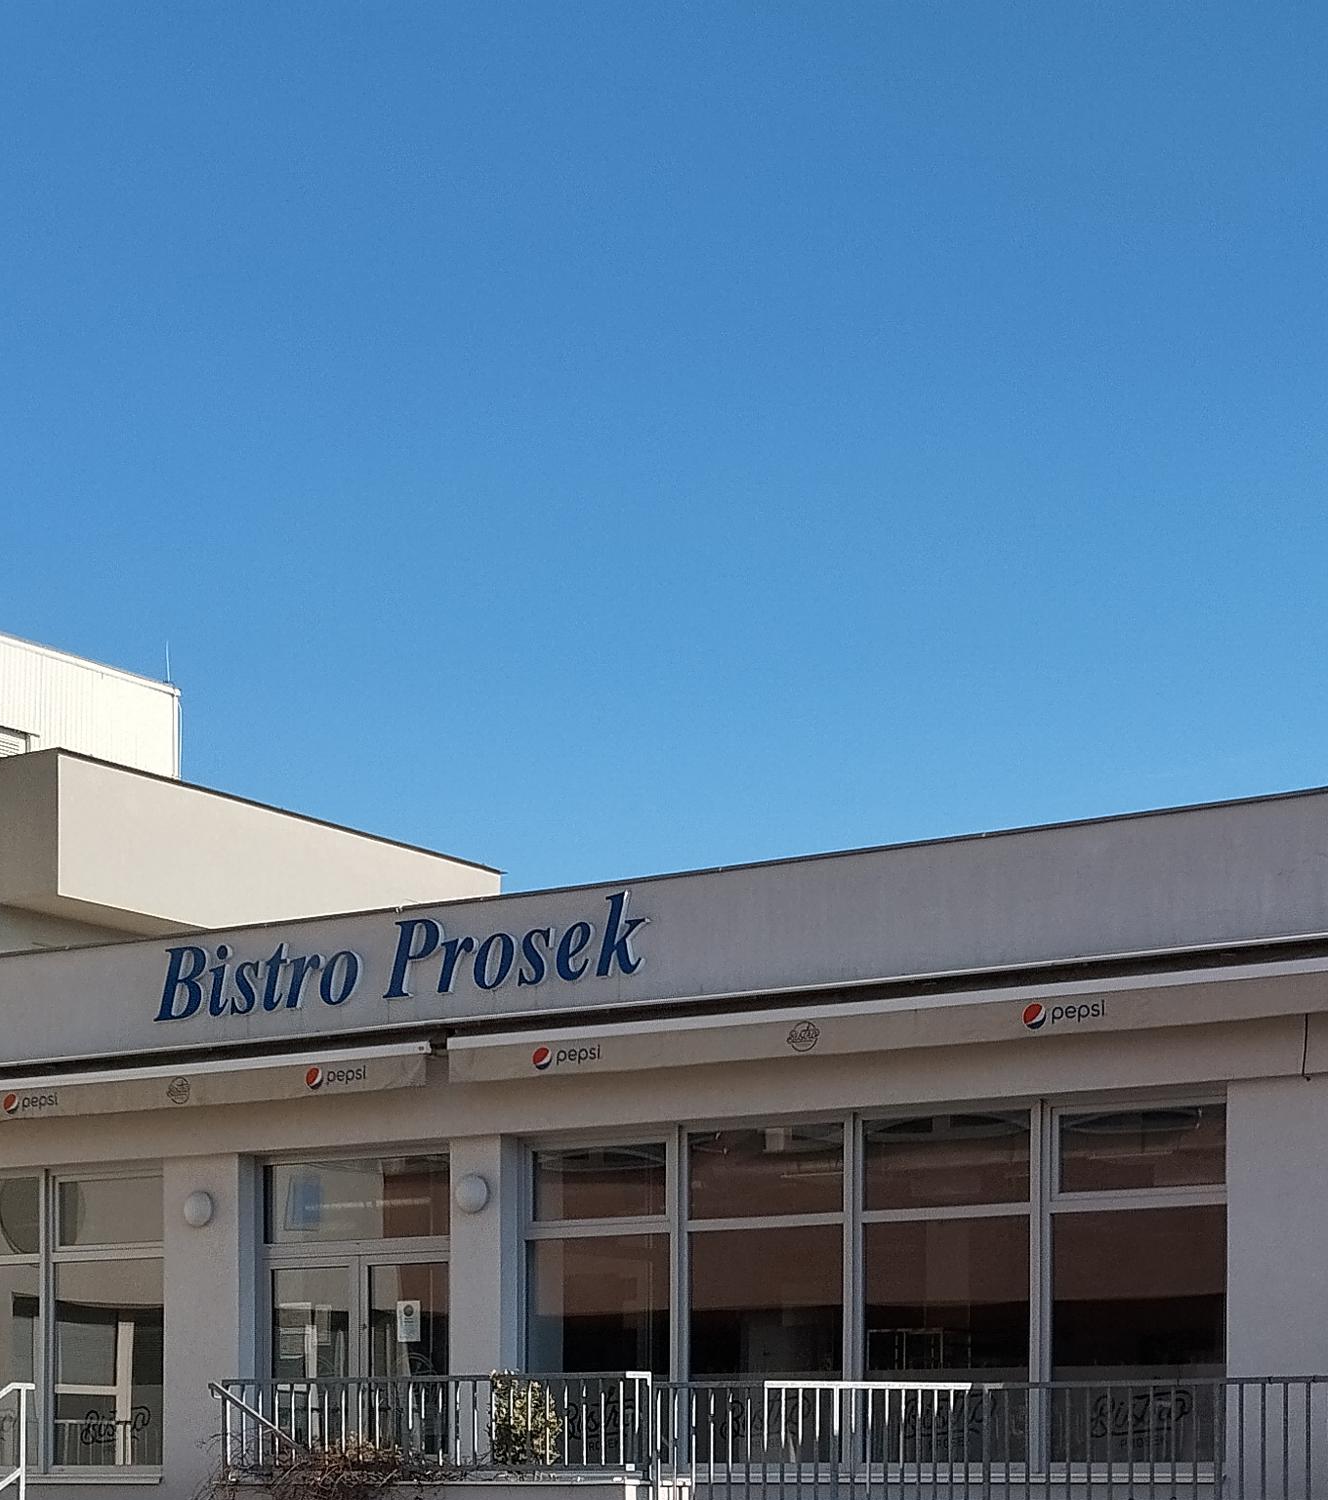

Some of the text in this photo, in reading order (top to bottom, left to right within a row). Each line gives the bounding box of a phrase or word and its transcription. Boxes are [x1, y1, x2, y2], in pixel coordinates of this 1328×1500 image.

[154, 888, 652, 1024] Bistro Prosek
[1051, 999, 1106, 1025] pepsi
[556, 1044, 601, 1065] pepsi
[326, 1065, 367, 1086] pepsi
[22, 1091, 58, 1111] pepsi
[567, 1385, 642, 1440] Bistr
